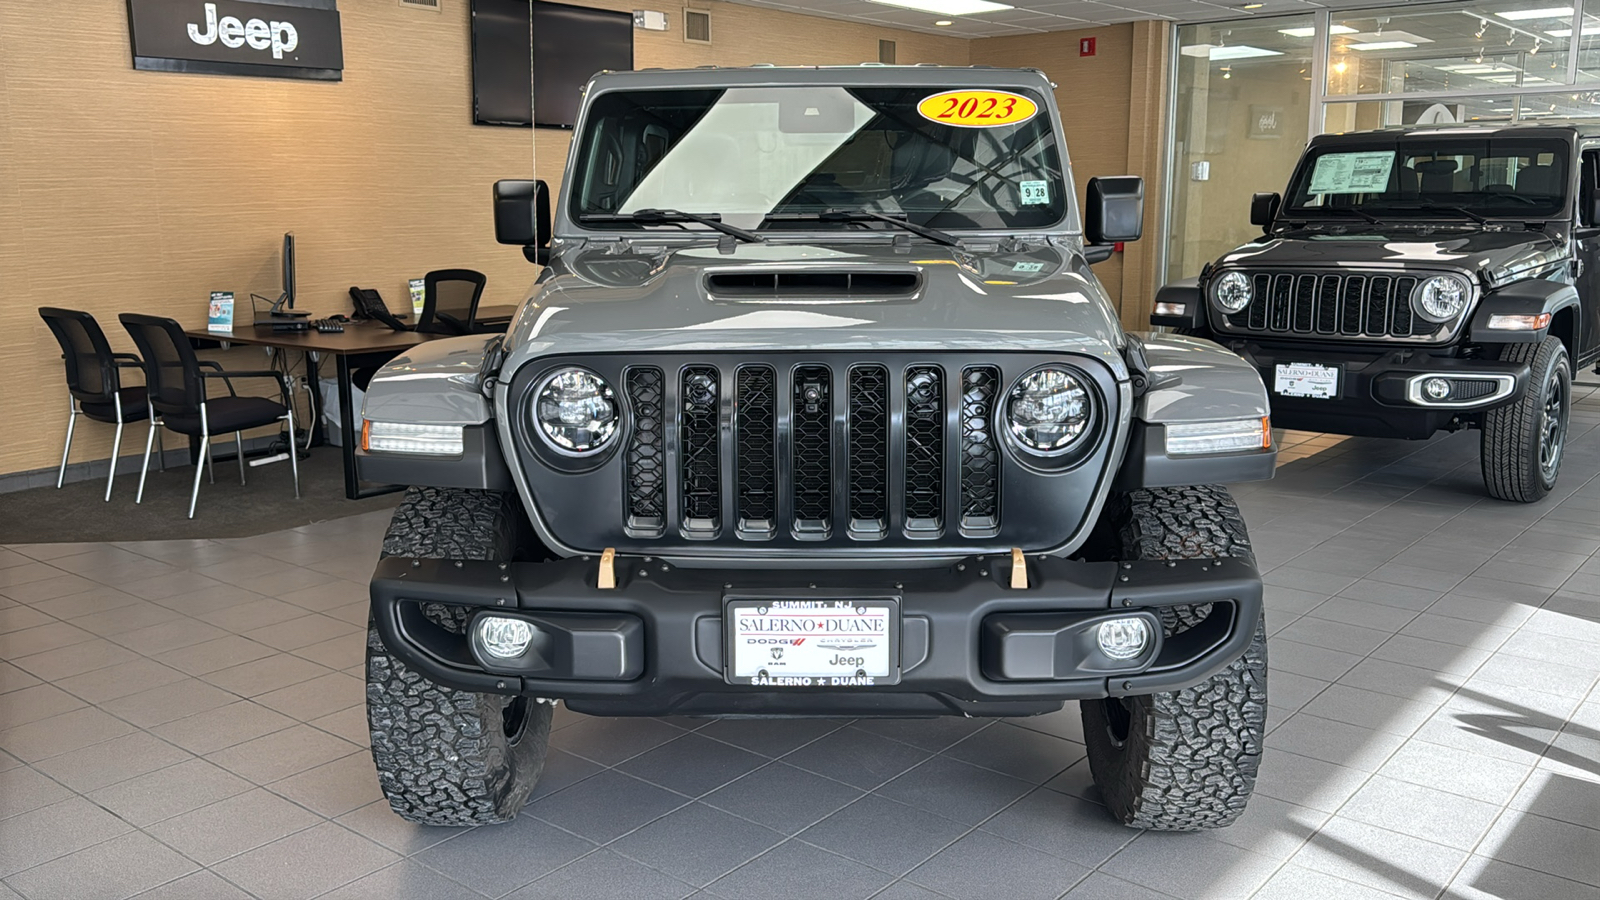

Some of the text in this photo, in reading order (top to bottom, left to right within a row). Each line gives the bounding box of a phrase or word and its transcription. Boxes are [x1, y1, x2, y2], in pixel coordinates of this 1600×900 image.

[187, 3, 298, 60] Jeep
[937, 98, 1017, 118] 2023
[1025, 188, 1045, 197] 9 28
[834, 601, 853, 609] NJ
[740, 618, 884, 632] SALERNO DUANE
[829, 654, 865, 667] Jeep
[751, 677, 875, 686] SALERNO DUANE
